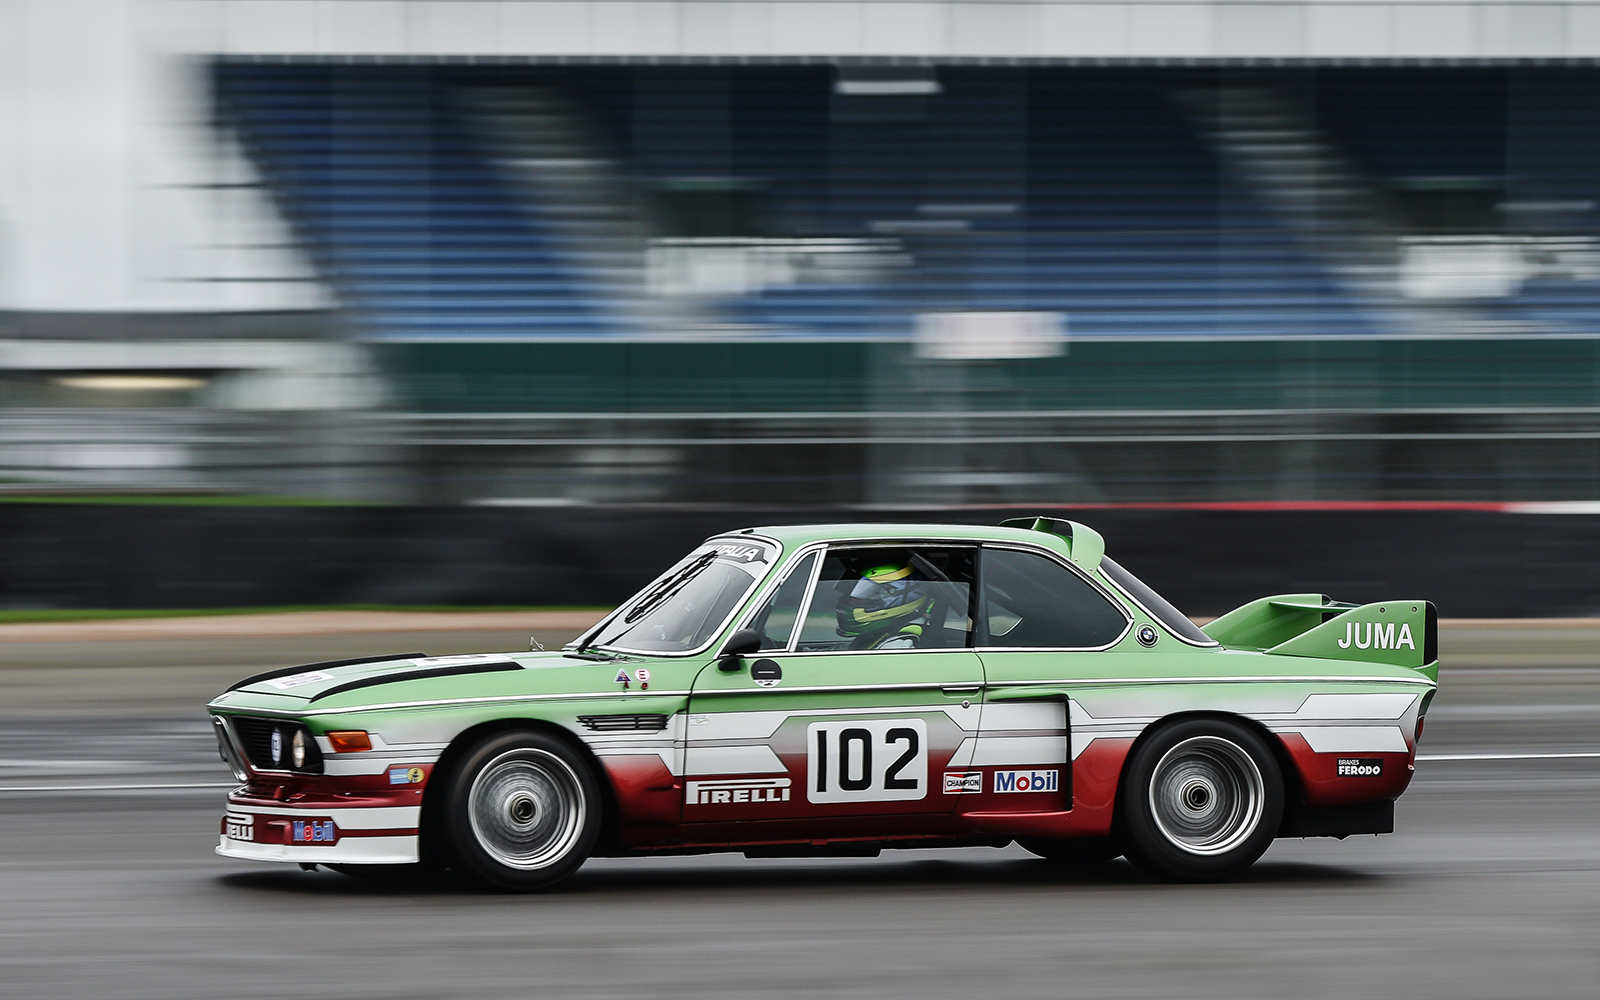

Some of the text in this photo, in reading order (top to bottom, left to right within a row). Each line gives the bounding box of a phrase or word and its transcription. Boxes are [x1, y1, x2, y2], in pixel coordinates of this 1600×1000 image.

[1338, 622, 1416, 650] JUMA
[816, 728, 919, 793] 102
[1338, 765, 1381, 776] FERODO
[686, 778, 792, 805] PIRELLI
[946, 779, 979, 788] CHAMPION
[996, 771, 1057, 791] Mobil
[292, 820, 335, 842] Mobil
